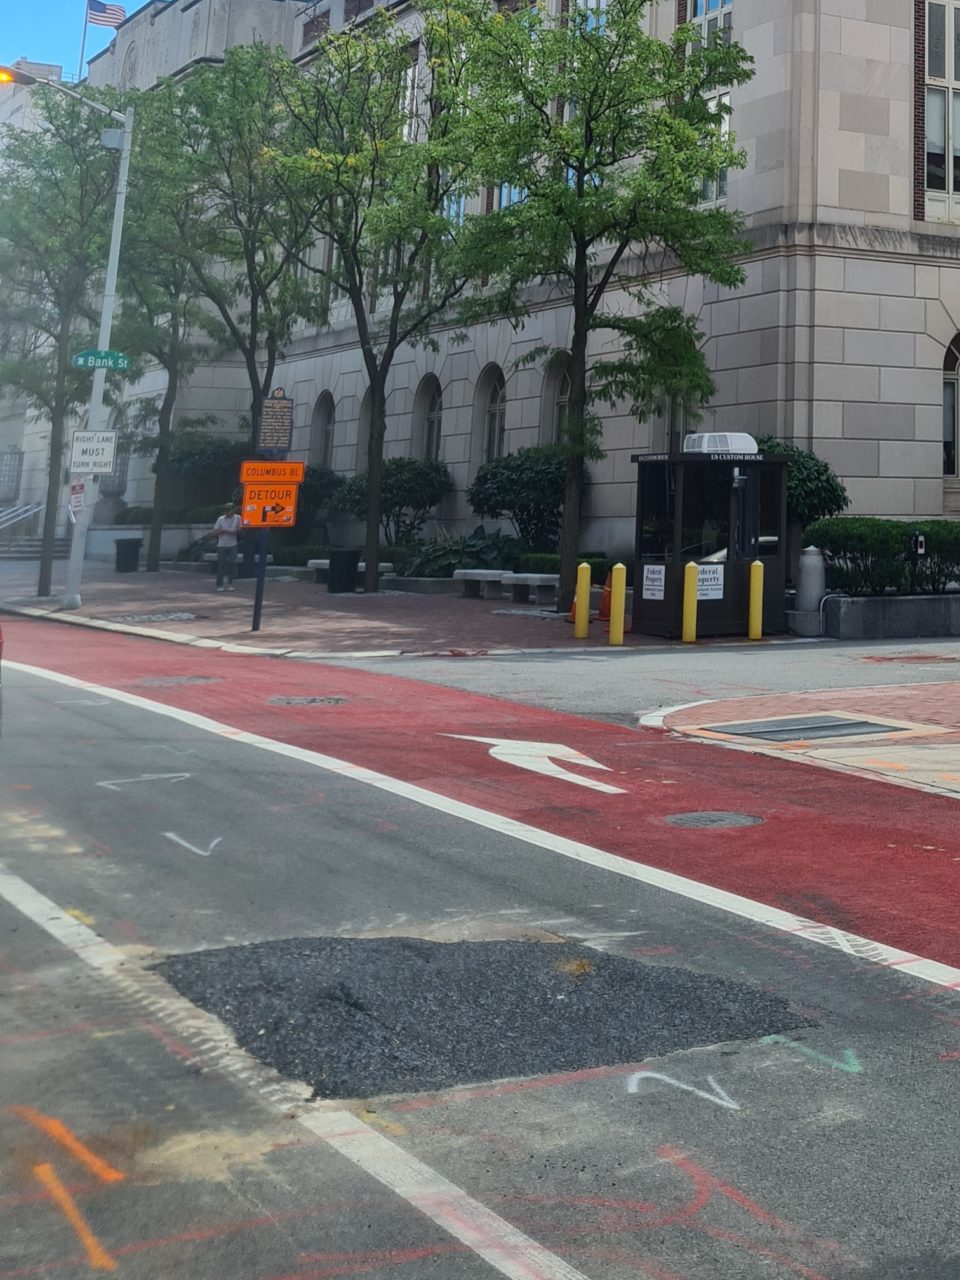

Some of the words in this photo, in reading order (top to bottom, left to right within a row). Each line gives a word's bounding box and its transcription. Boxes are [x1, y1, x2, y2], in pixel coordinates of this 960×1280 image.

[88, 356, 114, 367] Bank
[118, 358, 128, 368] St
[81, 448, 106, 456] MUST
[246, 467, 287, 477] COLUMBUS
[249, 490, 292, 500] DETOUR
